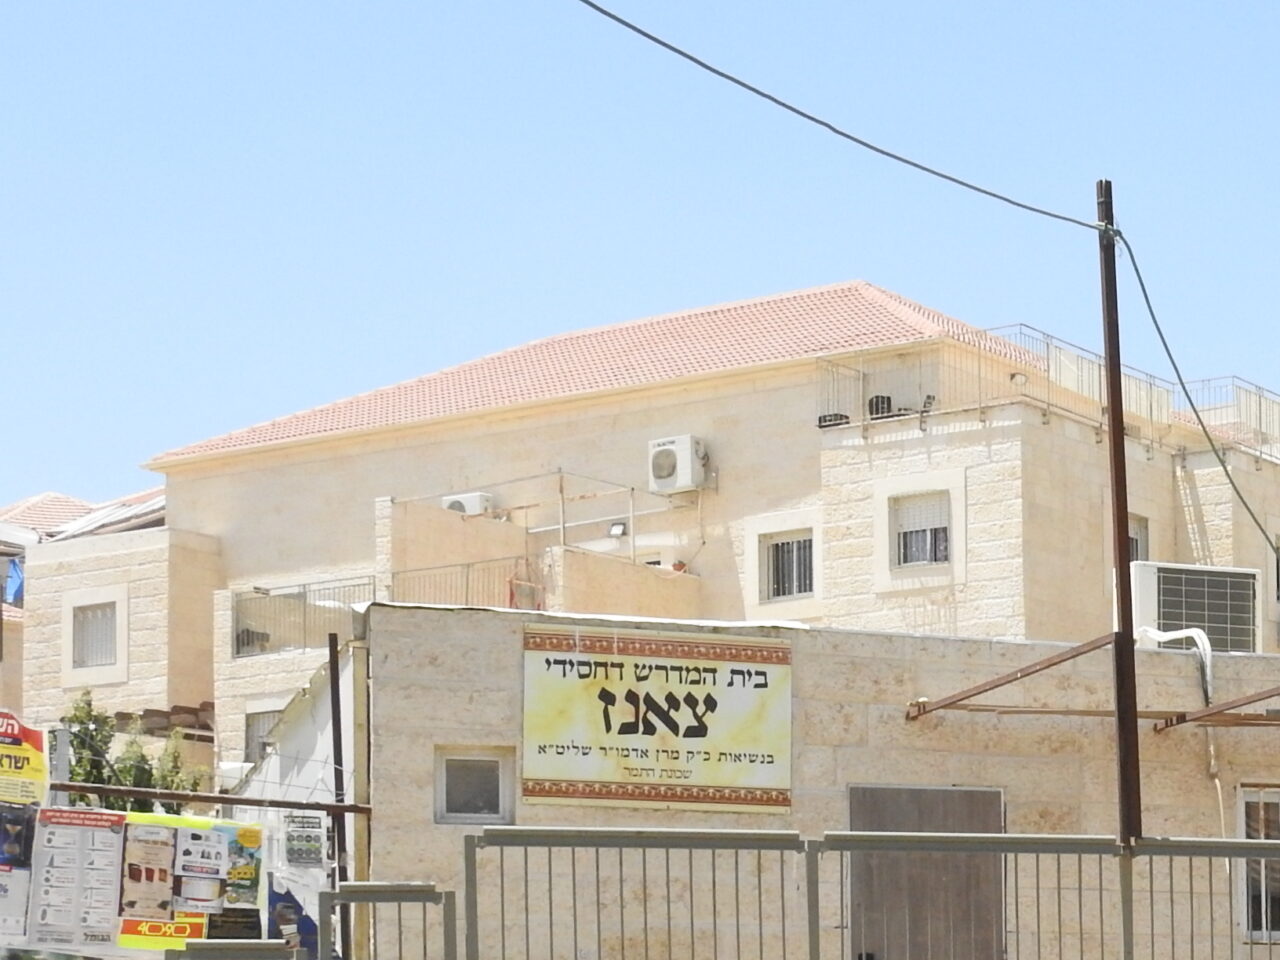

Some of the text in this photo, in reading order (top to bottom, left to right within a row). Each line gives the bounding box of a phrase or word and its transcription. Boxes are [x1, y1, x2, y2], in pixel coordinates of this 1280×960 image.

[544, 657, 769, 689] בית המדרש דחסידי
[597, 686, 718, 739] צאנז
[655, 749, 680, 764] מרן
[717, 752, 775, 766] בנשיאות
[622, 765, 694, 780] שכונת התמר
